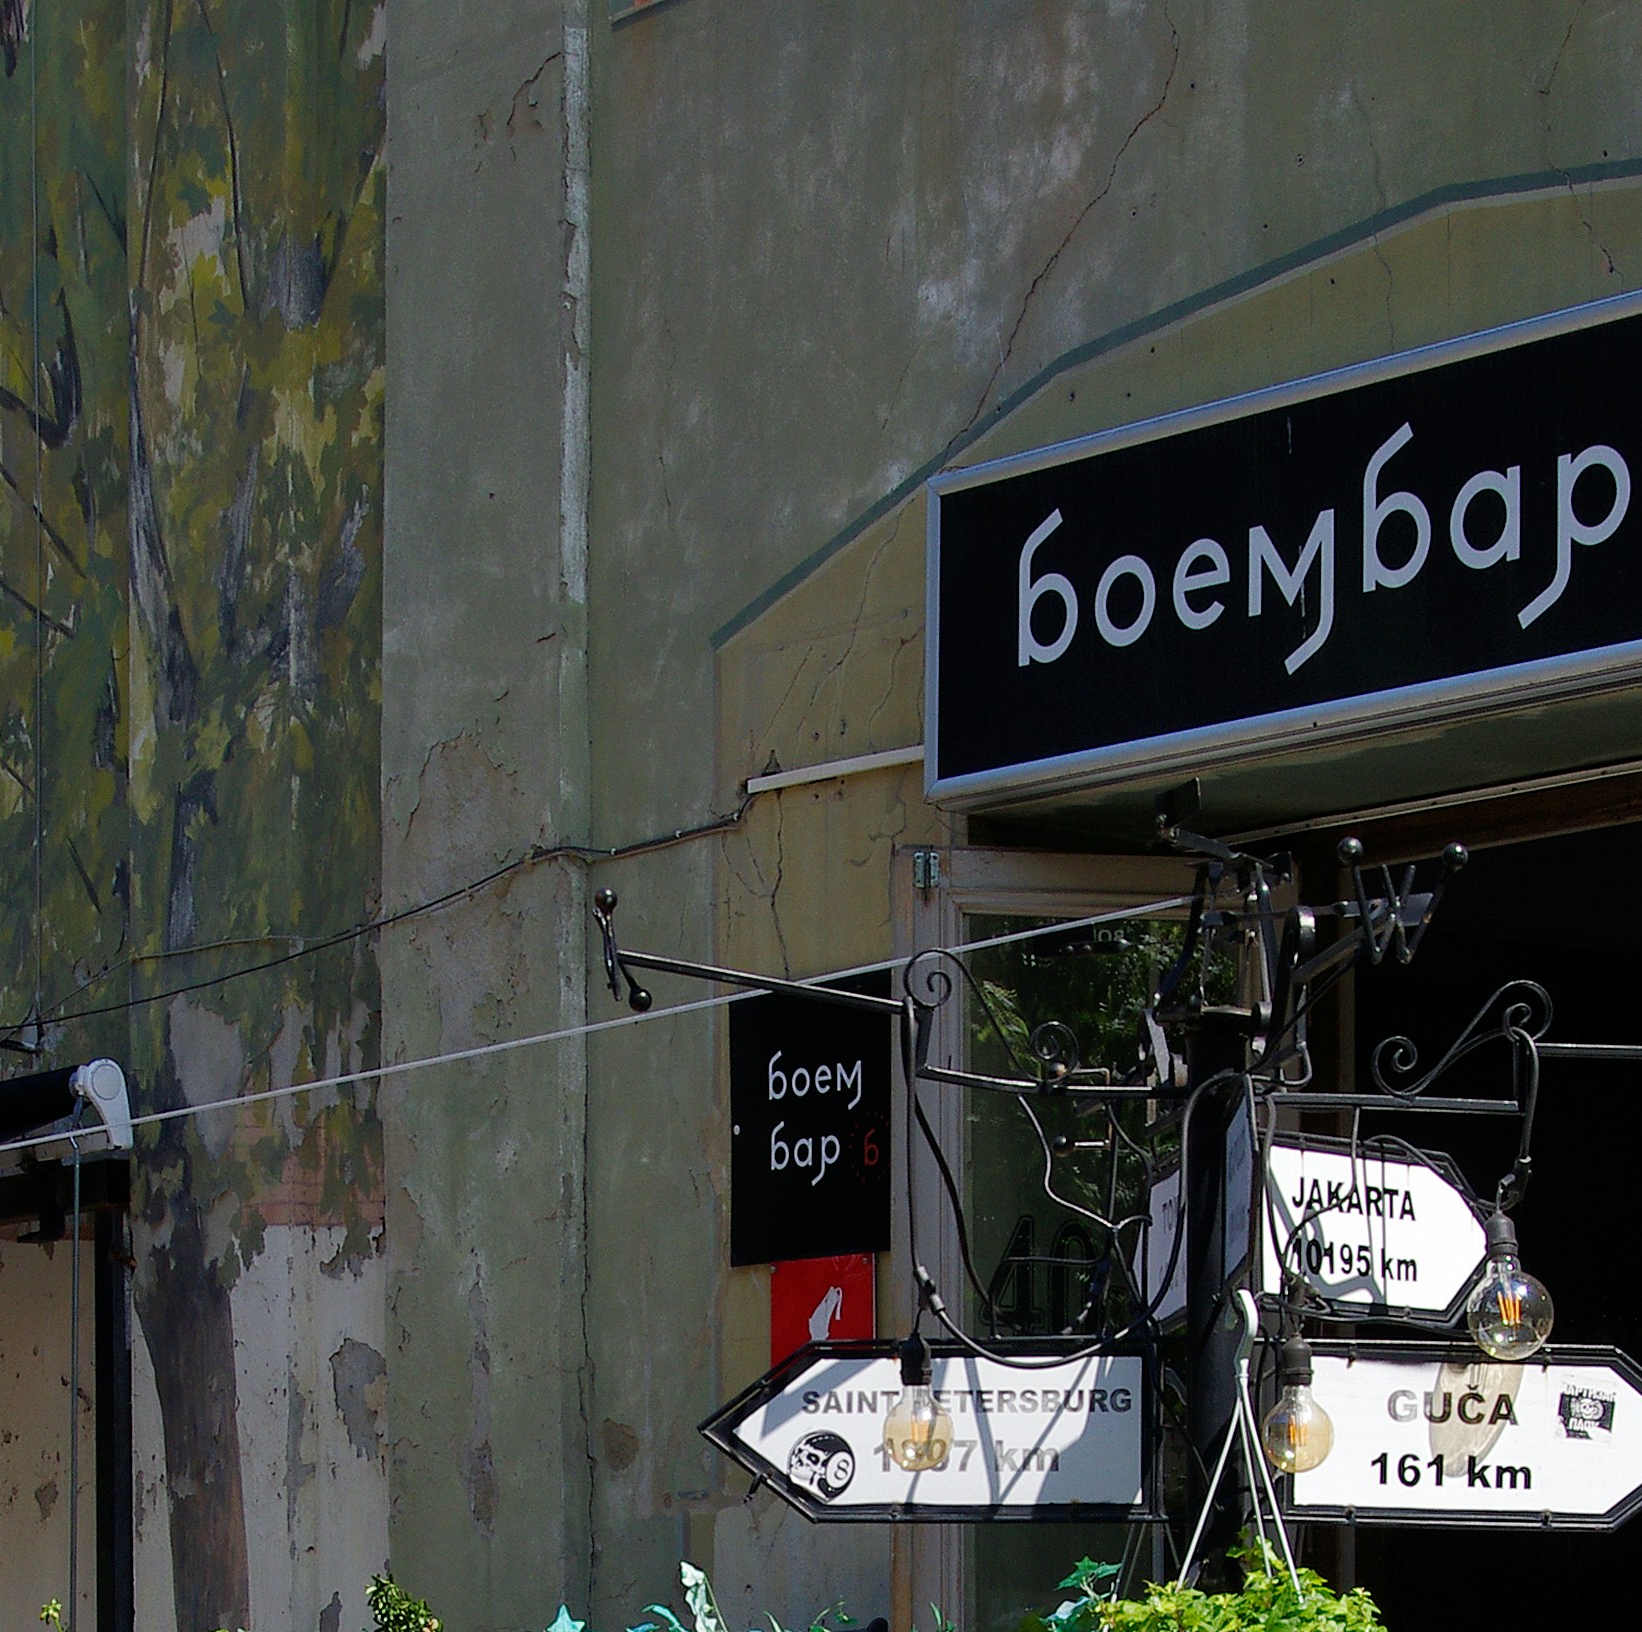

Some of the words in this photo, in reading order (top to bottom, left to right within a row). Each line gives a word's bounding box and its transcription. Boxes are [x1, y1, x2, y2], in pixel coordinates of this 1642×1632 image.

[1019, 422, 1632, 676] боембар
[768, 1050, 862, 1110] боем
[771, 1121, 841, 1186] бар
[1291, 1177, 1416, 1221] JAKARTA
[1291, 1238, 1371, 1278] 10195
[1380, 1246, 1418, 1282] km
[801, 1389, 900, 1414] SAINT
[913, 1388, 1132, 1413] ETERSBURG
[1387, 1384, 1519, 1426] GUČA
[834, 1459, 850, 1481] 8
[994, 1439, 1060, 1473] km
[1370, 1452, 1448, 1487] 161
[1467, 1455, 1532, 1490] km
